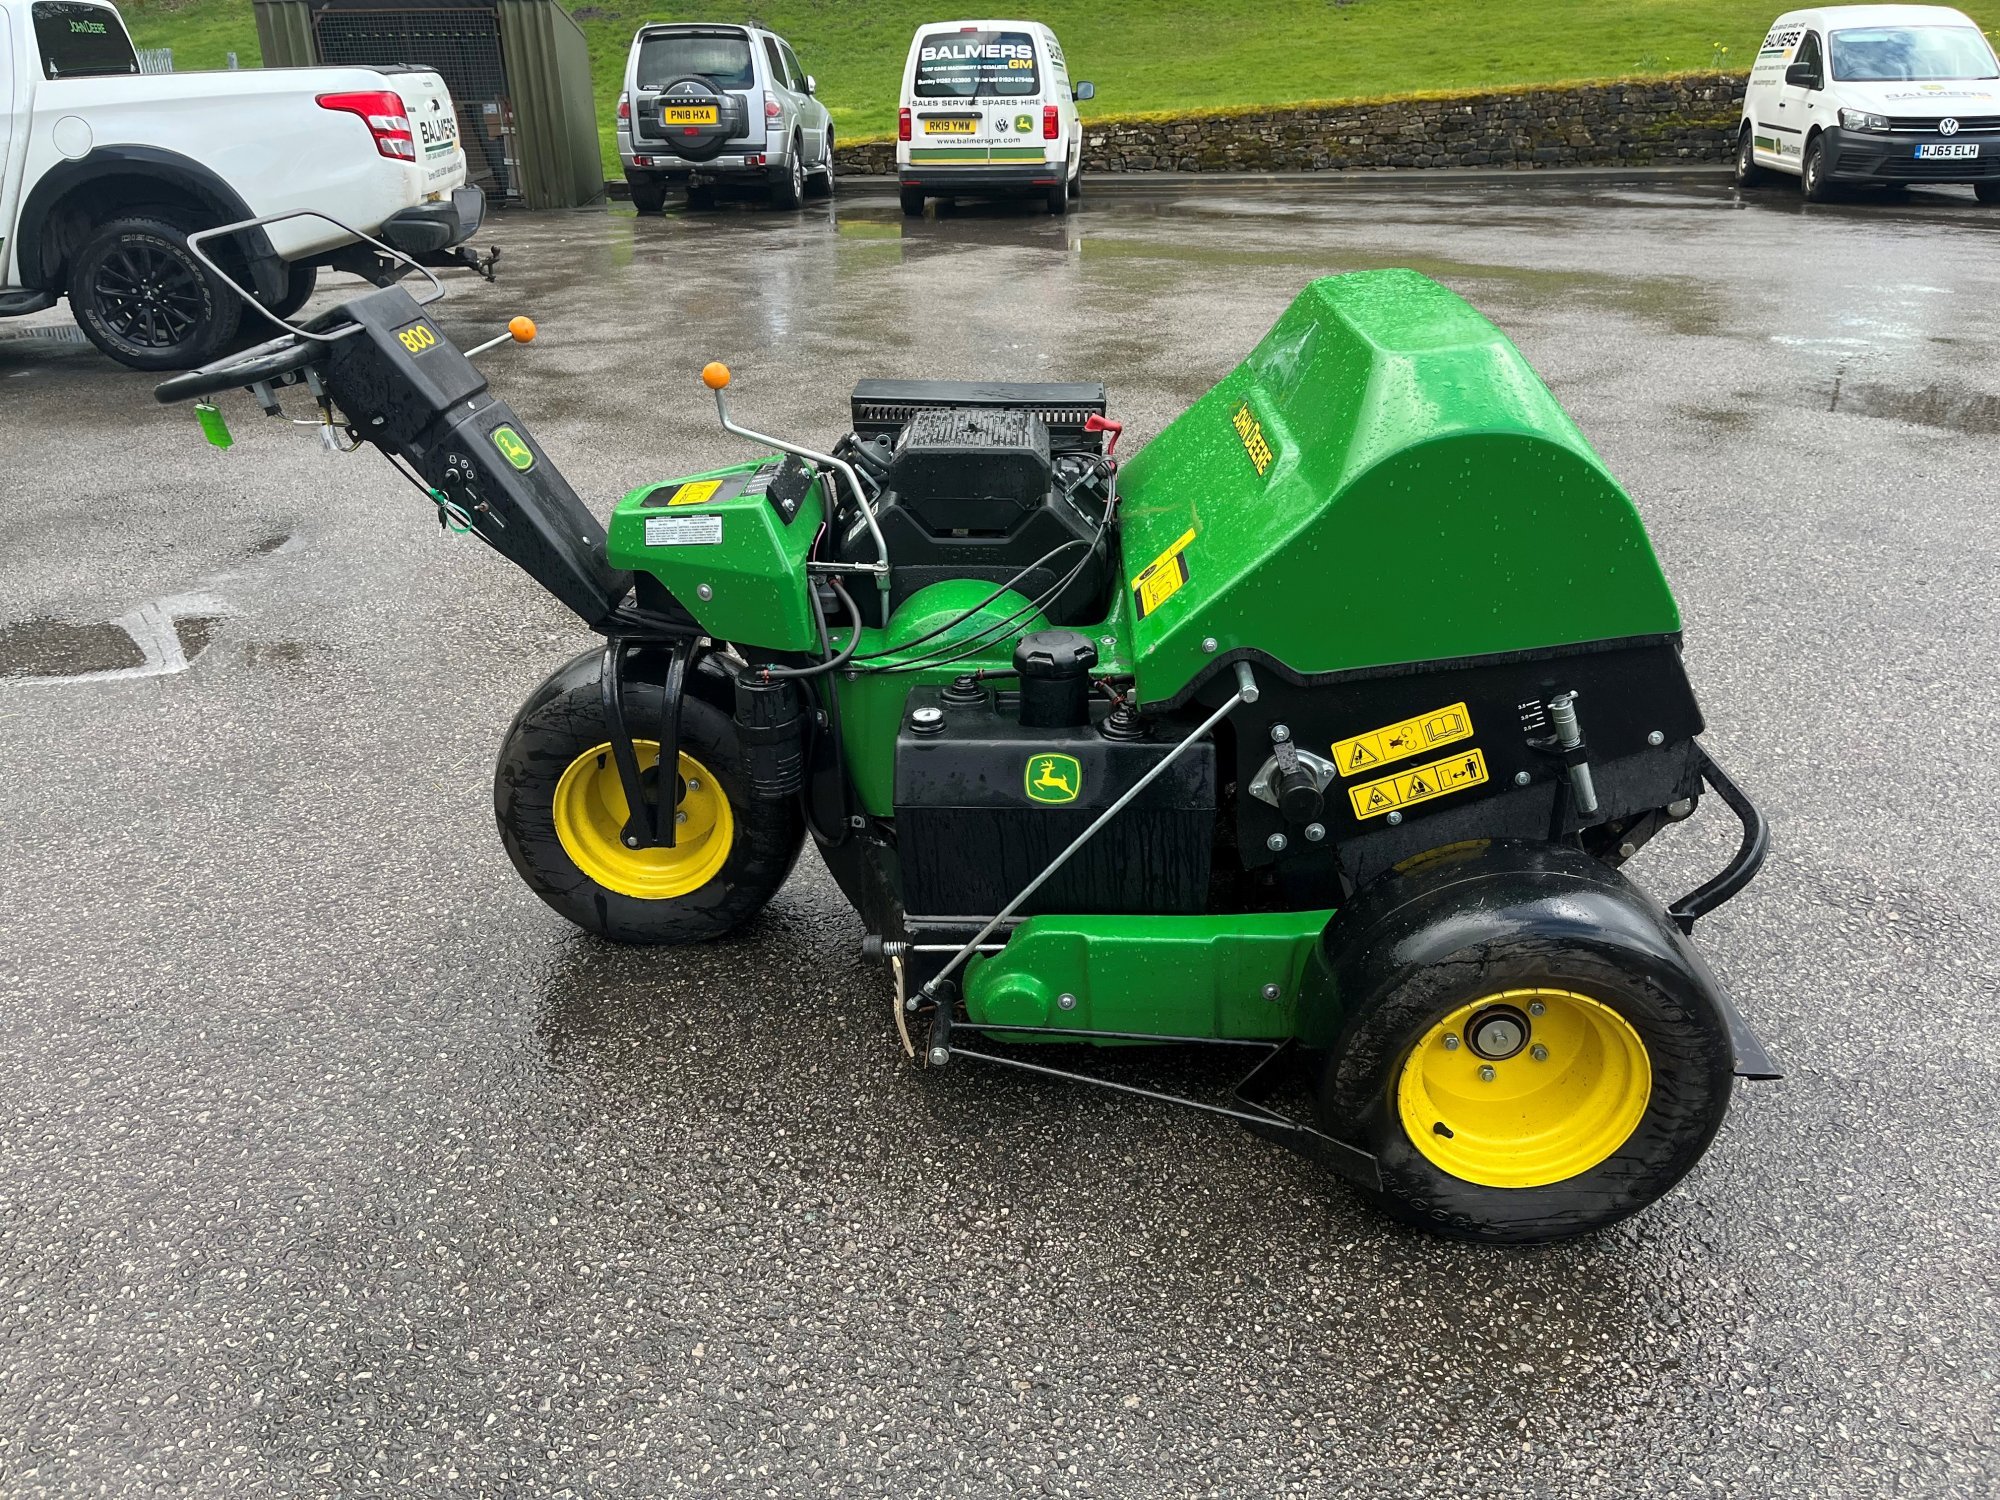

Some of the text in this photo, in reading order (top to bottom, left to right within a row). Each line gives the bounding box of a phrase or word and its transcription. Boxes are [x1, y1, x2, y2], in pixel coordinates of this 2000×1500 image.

[1763, 32, 1801, 48] BALMERS
[922, 45, 1032, 61] BALMERS
[1008, 60, 1032, 69] GM
[1885, 91, 1992, 99] BALMERS
[671, 110, 710, 119] PN18 HXA
[420, 118, 456, 143] BALMERS
[929, 121, 971, 131] RK19 YMW
[937, 137, 1020, 145] www.balmersgm.com
[1922, 145, 1977, 156] HJ65 ELH
[121, 234, 205, 282] DISCOVERER
[85, 309, 141, 357] COOPER
[399, 325, 435, 352] 800
[1233, 401, 1273, 476] JOHN DEERE
